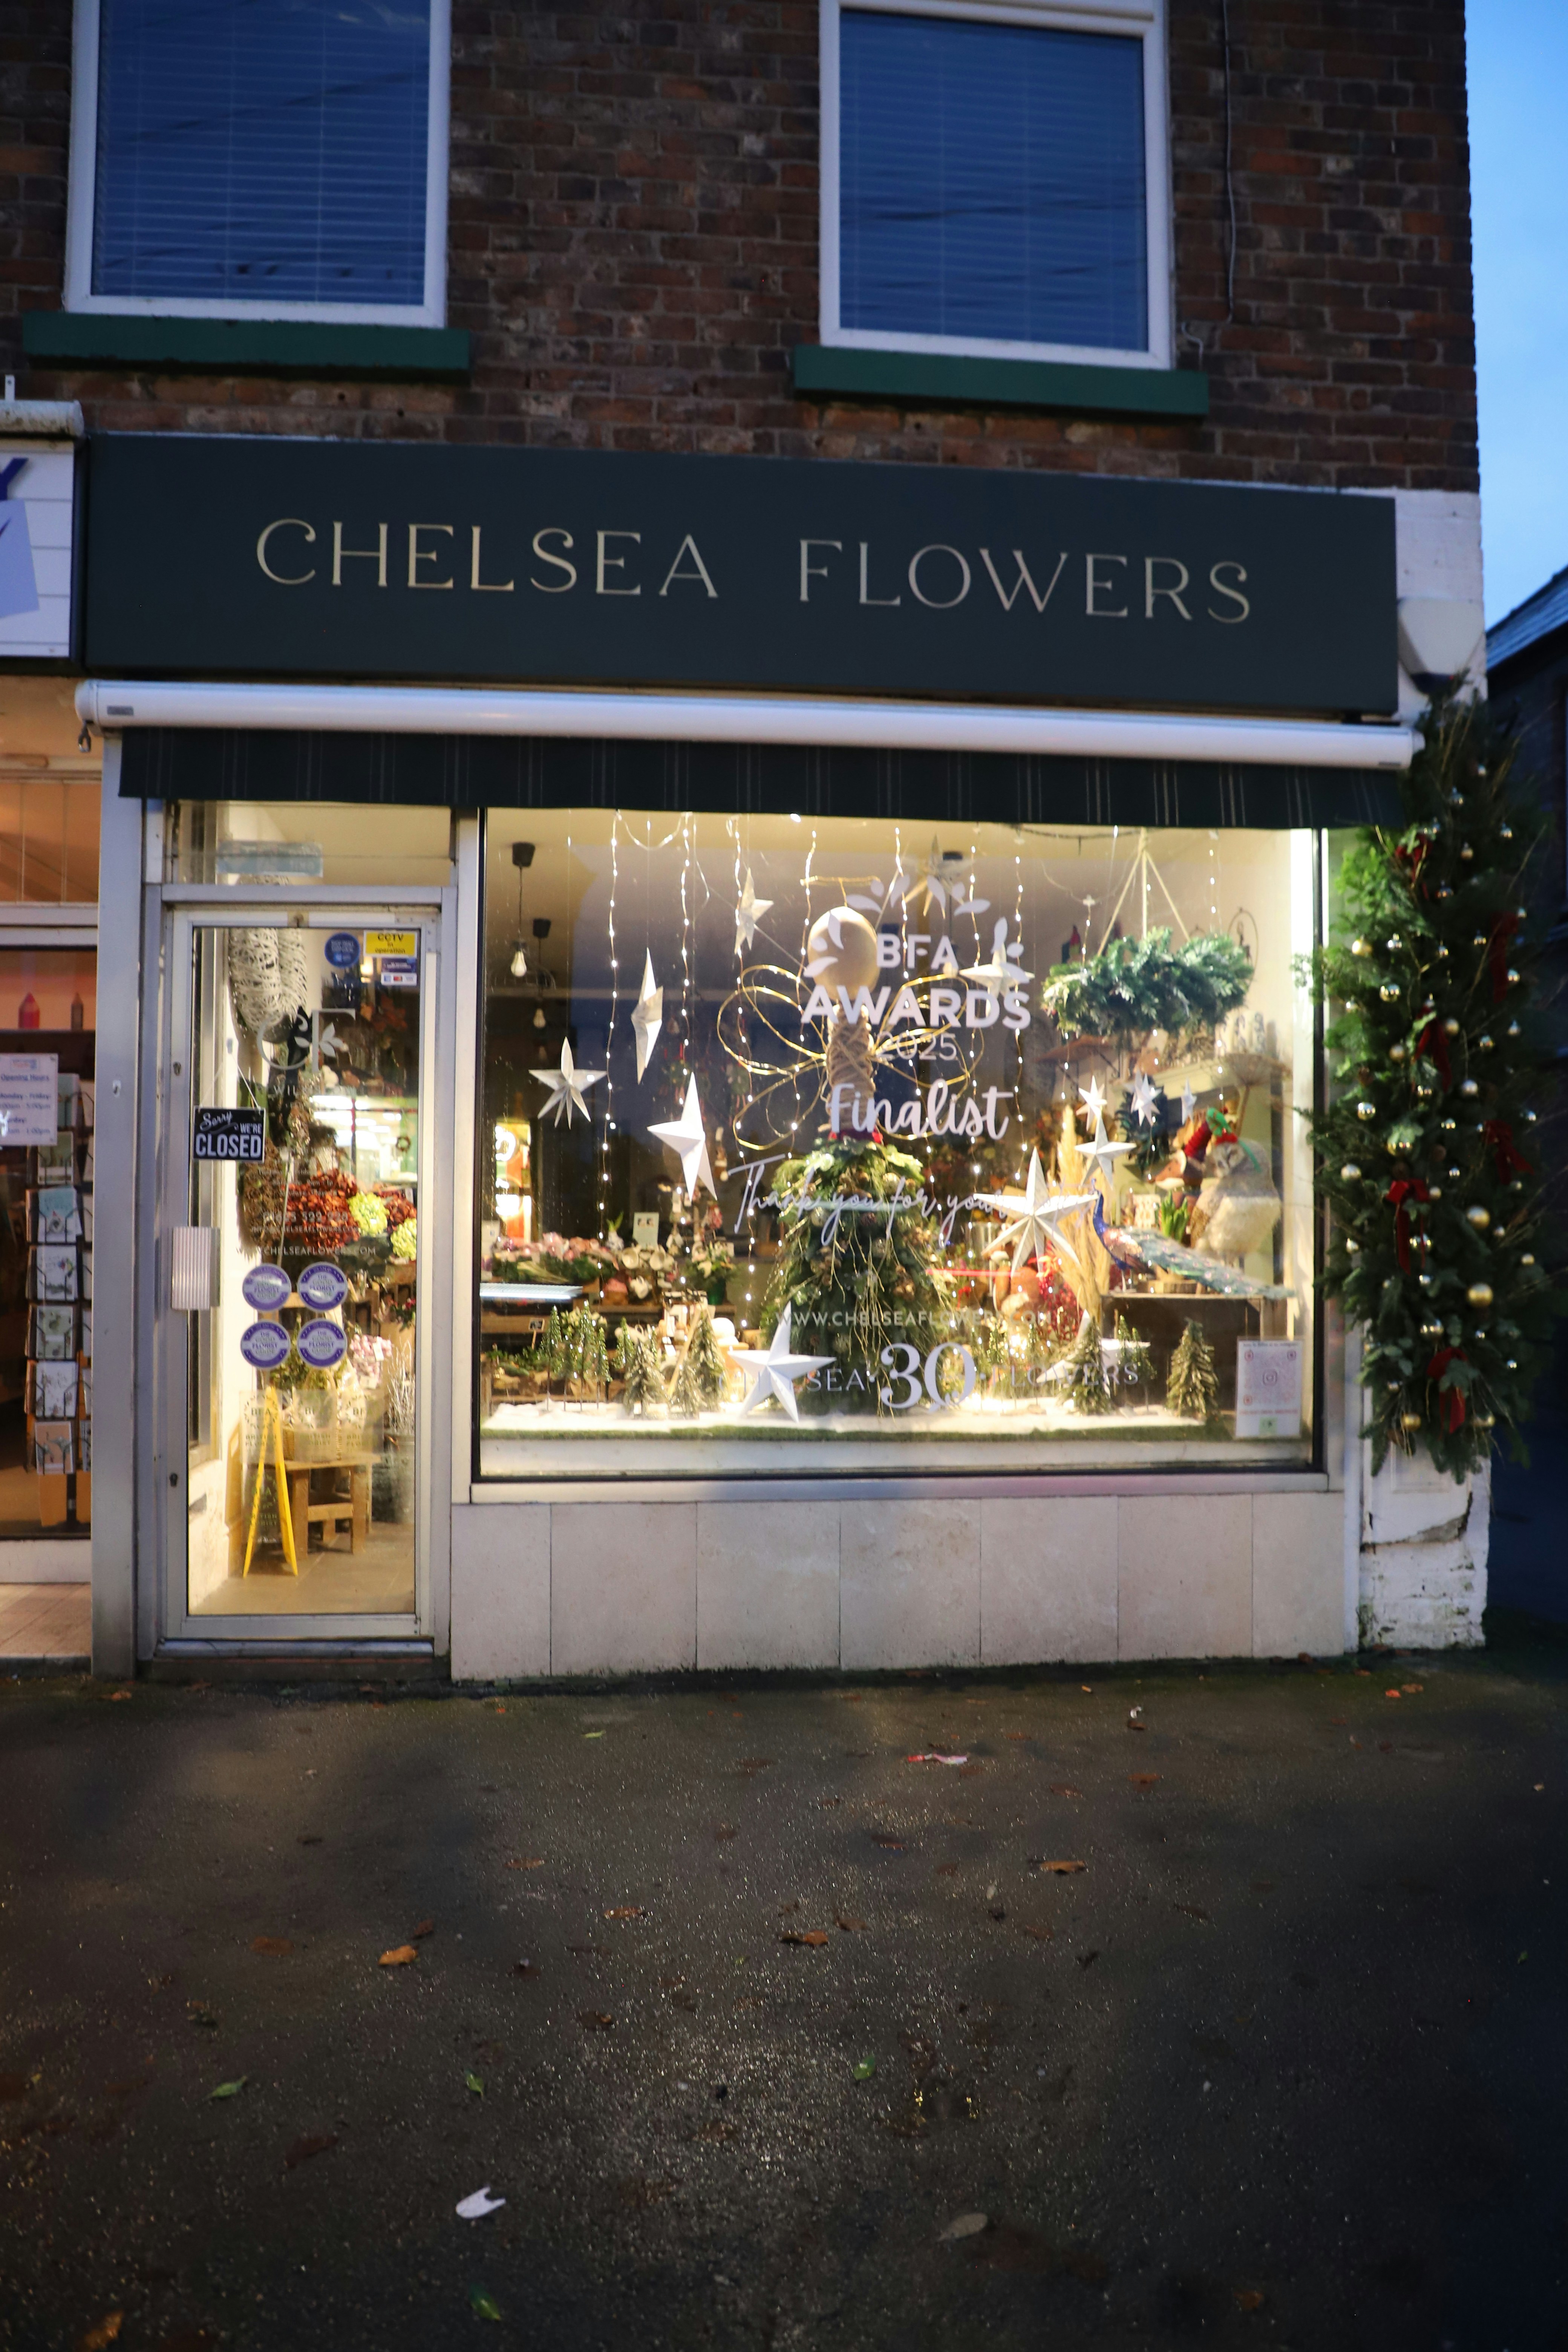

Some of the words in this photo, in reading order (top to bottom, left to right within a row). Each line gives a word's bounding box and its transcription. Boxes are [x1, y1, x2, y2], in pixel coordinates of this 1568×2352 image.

[257, 519, 718, 597] CHELSEA
[799, 539, 1250, 623] FLOWERS
[877, 933, 959, 970] BFA
[801, 985, 1031, 1030] AWARDS
[877, 1031, 957, 1061] 2025
[199, 1111, 233, 1132] Sorry
[240, 1122, 262, 1135] WE'RE
[195, 1133, 261, 1158] CLOSED
[727, 1153, 819, 1234] Thank
[821, 1193, 883, 1247] you
[885, 1176, 936, 1241] for
[880, 1341, 977, 1412] 30
